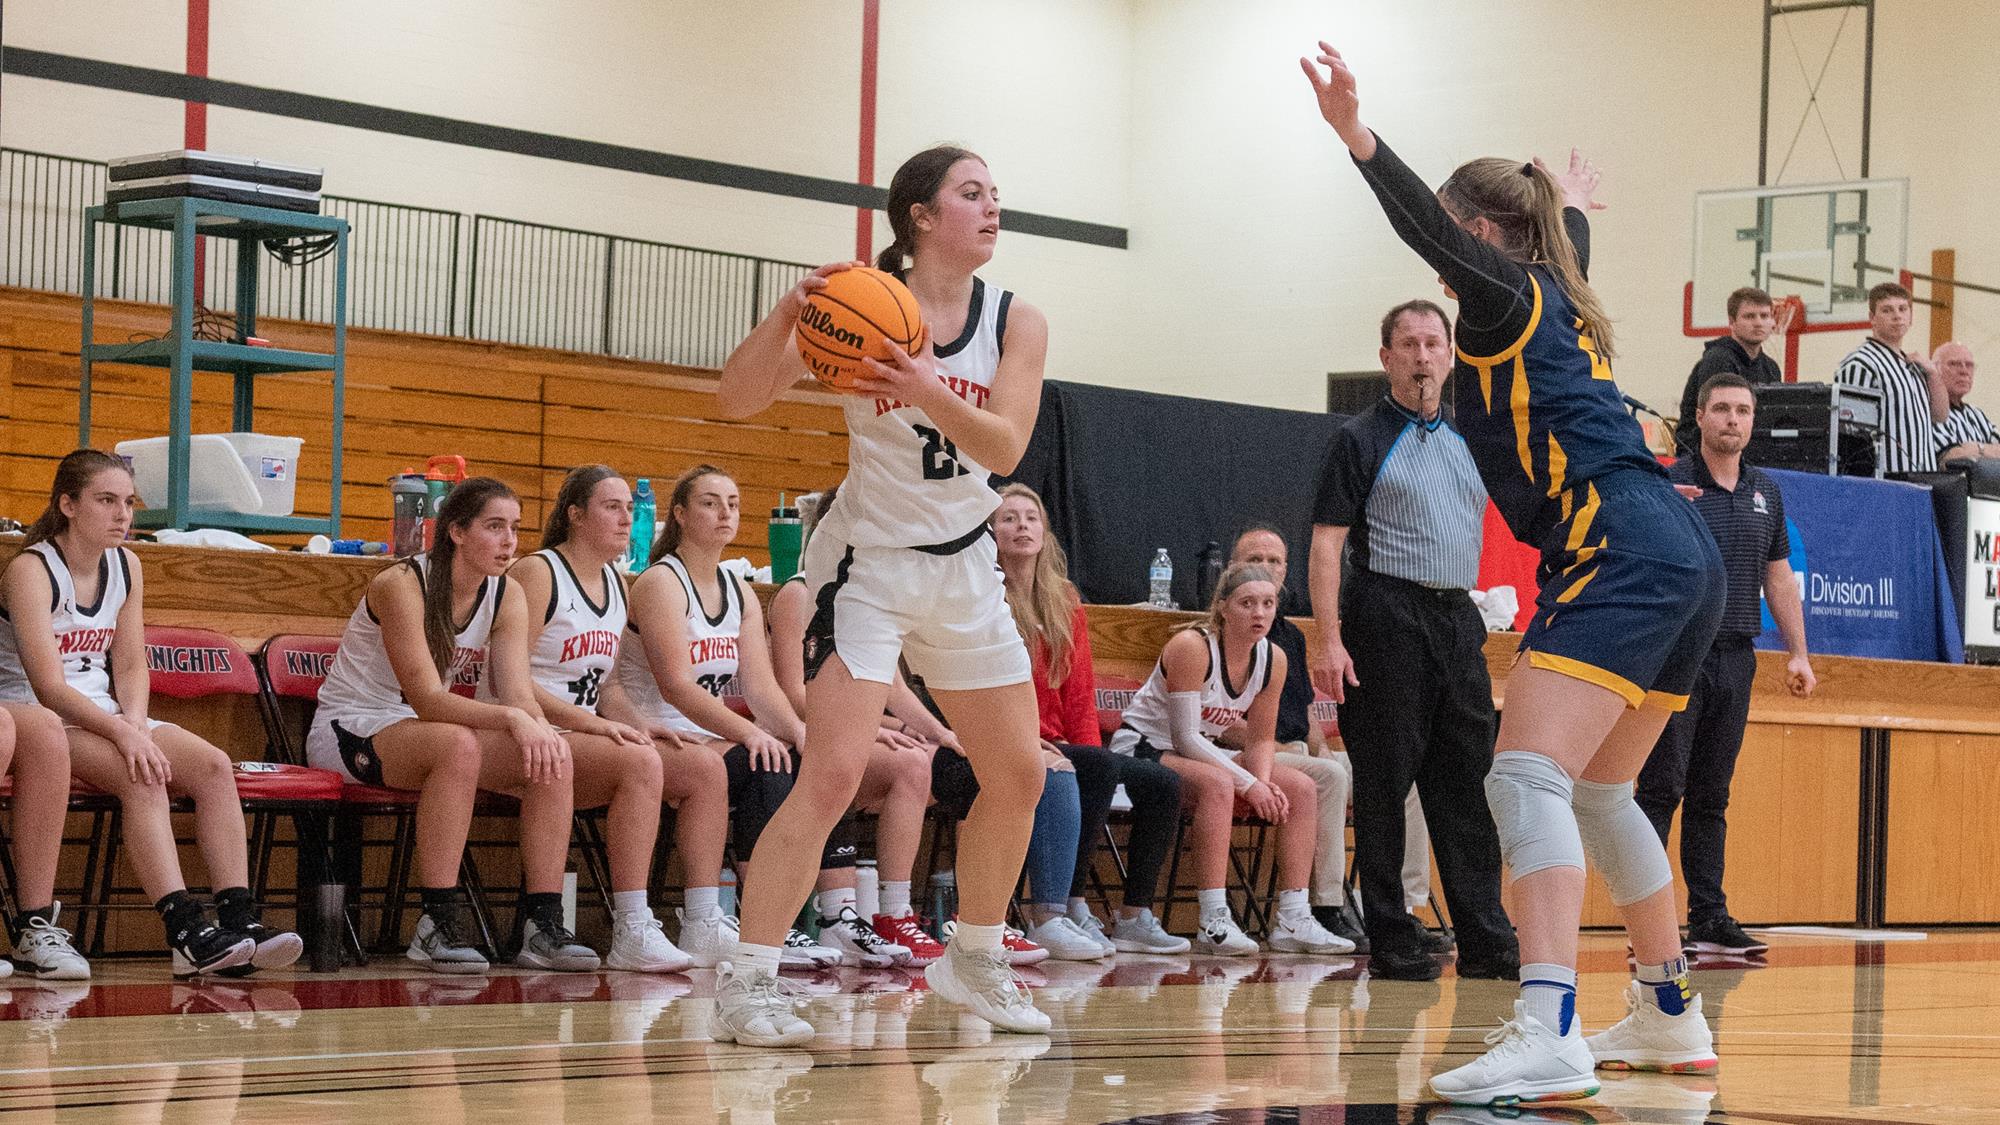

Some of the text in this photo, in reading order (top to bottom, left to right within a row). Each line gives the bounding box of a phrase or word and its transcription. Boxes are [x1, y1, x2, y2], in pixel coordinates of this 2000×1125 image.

[800, 301, 865, 351] Wilson
[1811, 572, 1893, 606] Division III
